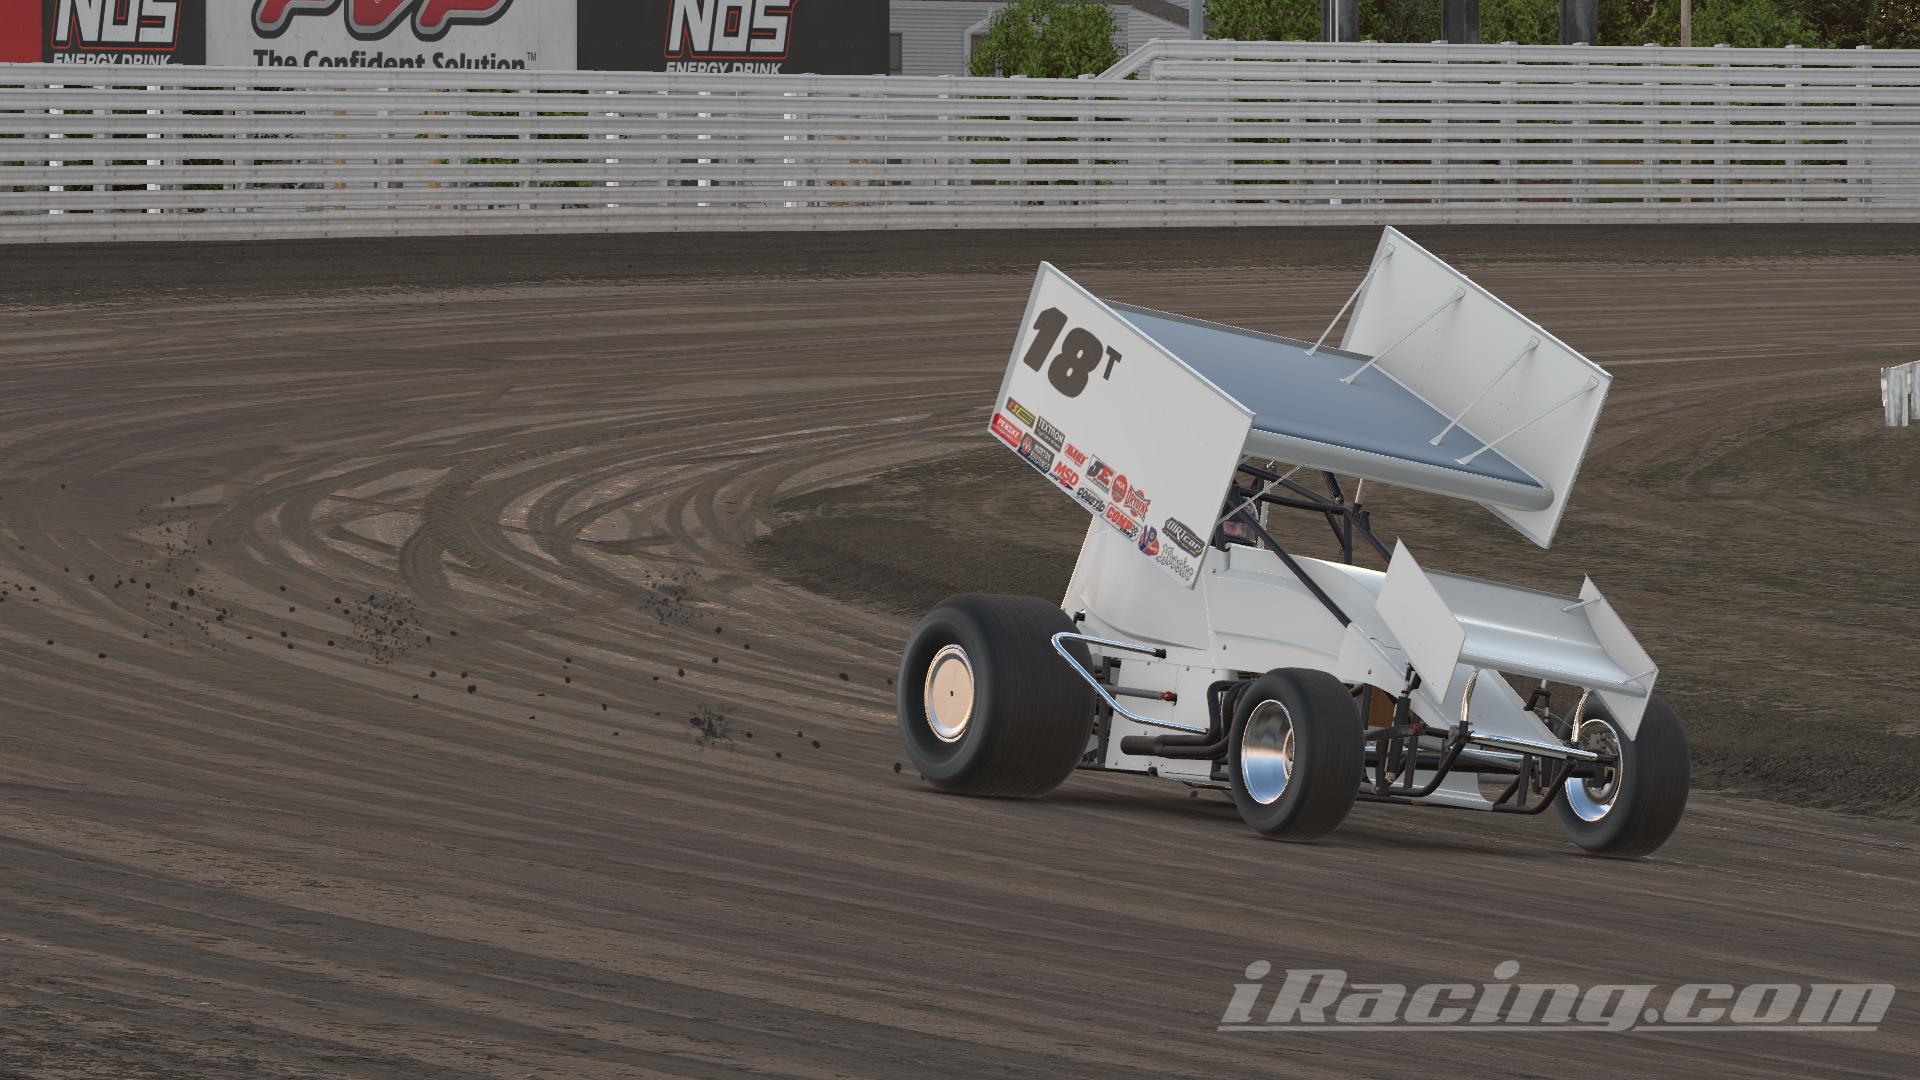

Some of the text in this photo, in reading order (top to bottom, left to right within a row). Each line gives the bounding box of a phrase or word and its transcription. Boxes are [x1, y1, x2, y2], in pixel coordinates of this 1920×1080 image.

[55, 0, 177, 42] NOS
[668, 0, 790, 53] NOS
[665, 61, 782, 74] ENERGY DRINK
[1038, 418, 1065, 444] TEXTRON
[1053, 460, 1079, 486] MSD
[1106, 506, 1133, 530] COMP
